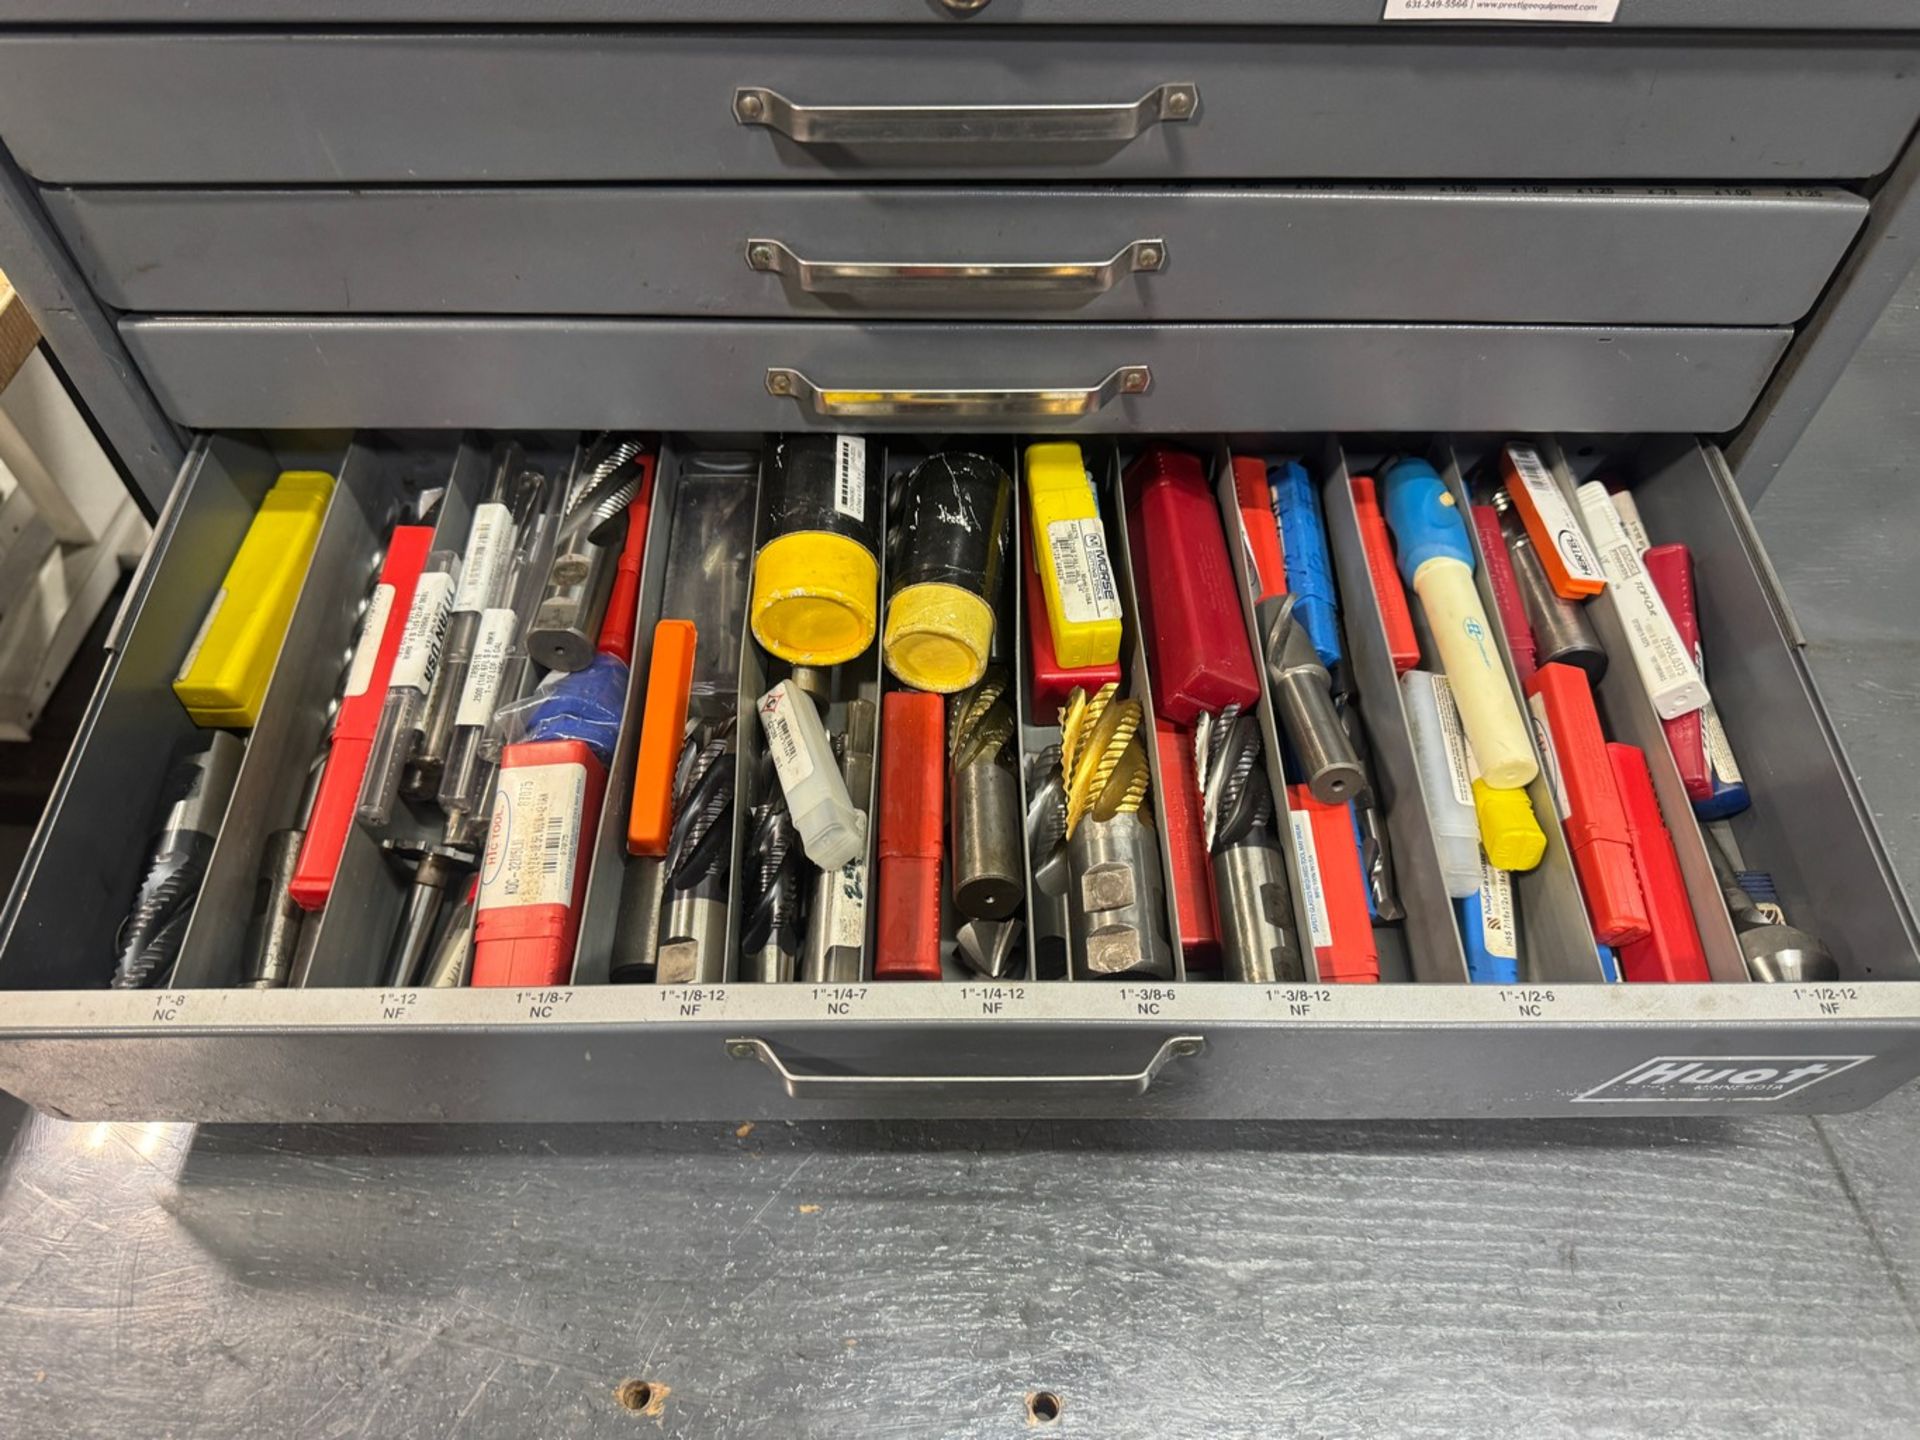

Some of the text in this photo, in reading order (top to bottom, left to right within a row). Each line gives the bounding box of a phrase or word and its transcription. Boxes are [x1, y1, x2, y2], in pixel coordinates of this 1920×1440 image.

[1405, 0, 1467, 8] 631-249-5566
[1476, 2, 1597, 11] www.prestigeequipment.com
[1096, 550, 1114, 599] MORSE
[423, 642, 443, 683] USA
[383, 1008, 405, 1019] NF
[529, 1006, 552, 1018] NC
[680, 1004, 701, 1016] NF
[827, 1003, 849, 1014] NC
[982, 1002, 1003, 1014] NF
[1137, 1003, 1160, 1015] NC
[1290, 1004, 1310, 1016] NF
[1519, 1005, 1542, 1017] NC
[1820, 1002, 1840, 1014] NF
[153, 1009, 176, 1021] NC
[1626, 1063, 1829, 1084] Huot
